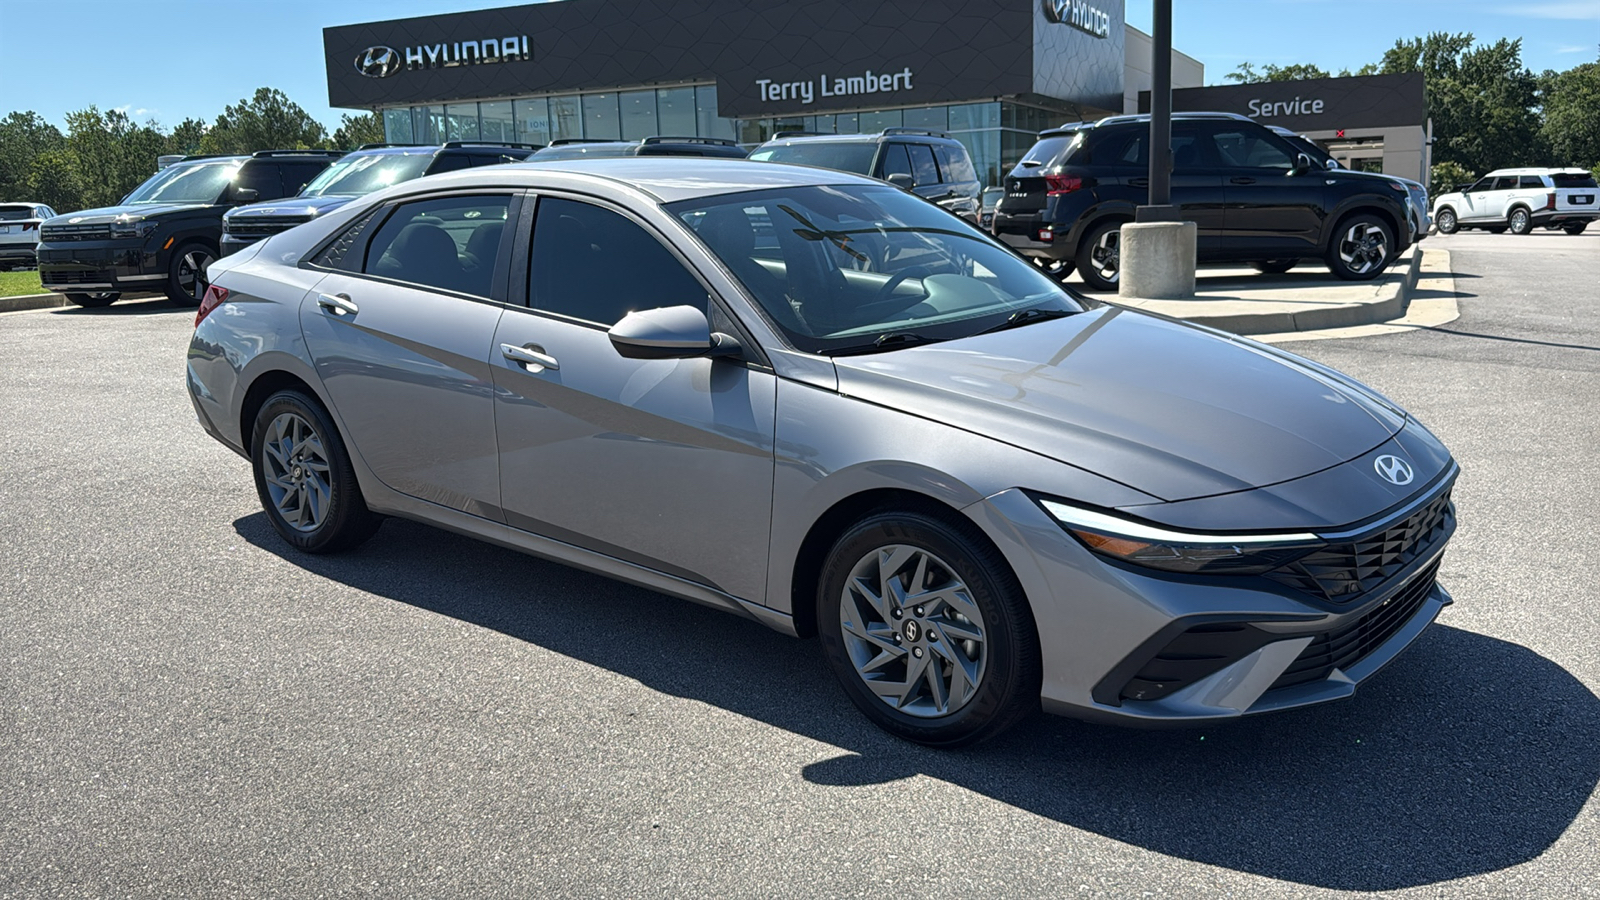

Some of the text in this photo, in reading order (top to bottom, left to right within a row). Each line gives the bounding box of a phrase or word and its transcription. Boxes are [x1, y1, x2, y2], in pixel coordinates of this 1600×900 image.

[1072, 0, 1110, 36] HYUNDAI
[405, 35, 529, 70] HYUNDAI
[755, 67, 913, 104] Terry Lambert
[1247, 96, 1324, 118] Service
[956, 558, 1000, 625] KUMHO
